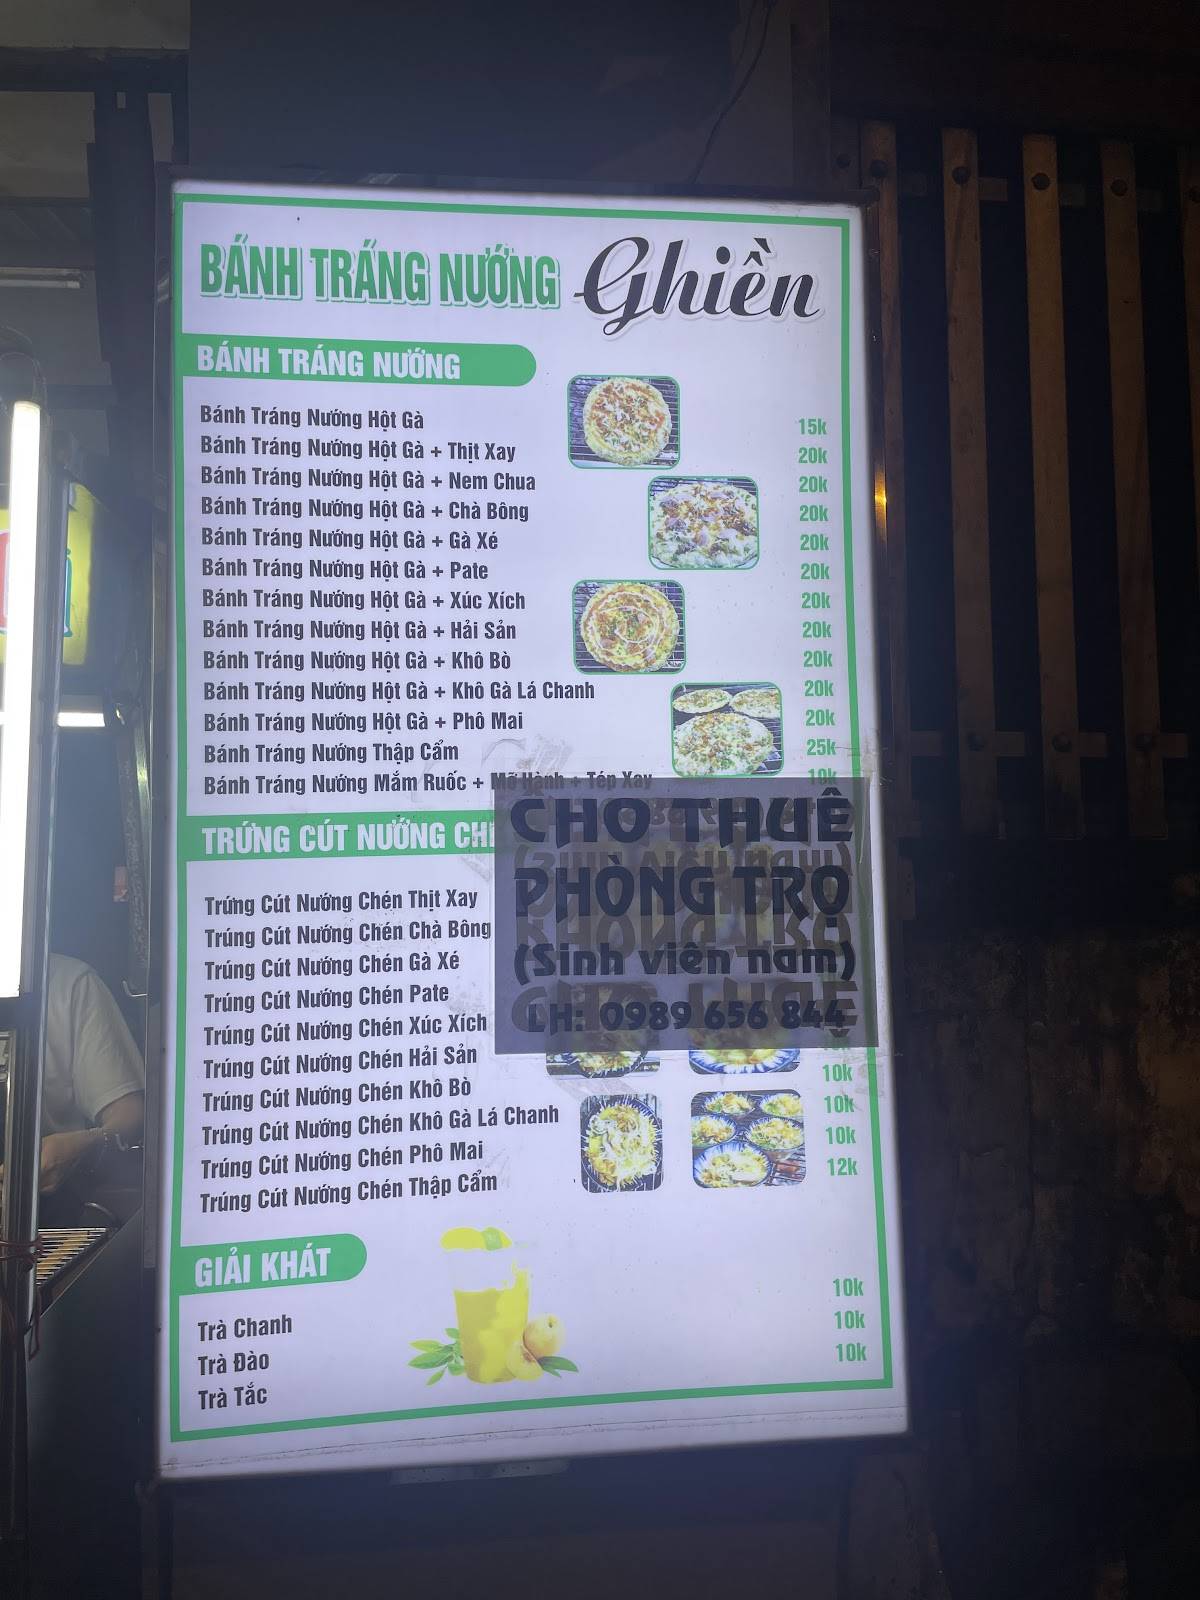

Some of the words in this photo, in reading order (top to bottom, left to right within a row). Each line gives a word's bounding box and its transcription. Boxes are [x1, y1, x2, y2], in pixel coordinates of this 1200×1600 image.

[200, 233, 300, 298] BÁNH
[310, 238, 429, 302] TRÁNG
[439, 244, 558, 305] NƯỚNG
[574, 237, 820, 335] Ghiền
[197, 341, 270, 374] BÁNH
[278, 344, 364, 377] TRÁNG
[373, 347, 461, 379] NƯỚNG
[201, 405, 246, 423] Bánh
[251, 407, 301, 427] Tráng
[308, 409, 363, 429] Nướng
[369, 411, 397, 432] Hột
[402, 411, 424, 428] Gà
[800, 419, 826, 435] 15k
[201, 435, 246, 454] Bánh
[252, 437, 302, 458] Tráng
[308, 439, 363, 459] Nướng
[369, 440, 397, 461] Hột
[403, 441, 424, 458] Gà
[448, 442, 480, 463] Thịt
[485, 443, 516, 462] Xay
[800, 447, 827, 464] 20k
[203, 558, 248, 576] Bánh
[253, 559, 303, 579] Tráng
[310, 560, 365, 580] Nướng
[371, 560, 399, 582] Hột
[404, 561, 426, 578] Gà
[451, 562, 489, 579] Pate
[800, 563, 831, 579] 20k
[203, 588, 248, 607] Bánh
[254, 589, 304, 609] Tráng
[310, 590, 365, 610] Nướng
[371, 591, 400, 612] Hột
[405, 591, 426, 608] Gà
[451, 591, 482, 609] Xúc
[488, 592, 526, 609] Xích
[801, 592, 830, 608] 20k
[204, 650, 249, 669] Bánh
[255, 650, 305, 671] Tráng
[311, 651, 366, 671] Nướng
[372, 651, 400, 673] Hột
[406, 651, 428, 669] Gà
[452, 652, 484, 669] Khô
[490, 651, 511, 669] Bò
[804, 650, 832, 668] 20k
[204, 682, 249, 700] Bánh
[255, 682, 305, 702] Tráng
[312, 681, 367, 701] Nướng
[373, 682, 401, 703] Hột
[407, 681, 428, 699] Gà
[453, 682, 485, 699] Khô
[491, 681, 512, 699] Gà
[518, 681, 537, 699] Lá
[543, 682, 595, 698] Chanh
[804, 680, 832, 697] 20k
[205, 744, 250, 763] Bánh
[256, 744, 306, 764] Tráng
[313, 743, 367, 763] Nướng
[373, 743, 415, 764] Thập
[421, 739, 459, 760] Cẩm
[806, 739, 835, 756] 25k
[205, 776, 250, 794] Bánh
[256, 775, 306, 795] Tráng
[313, 774, 368, 794] Nướng
[375, 771, 418, 791] Mắm
[424, 770, 467, 790] Ruốc
[522, 771, 564, 789] Hành
[586, 771, 616, 790] Tép
[622, 771, 653, 789] Xay
[510, 797, 651, 848] CHO
[672, 787, 853, 848] THUÊ
[202, 820, 291, 855] TRỨNG
[300, 819, 348, 852] CÚT
[357, 817, 446, 850] NƯỚNG
[454, 820, 495, 849] CH
[205, 896, 255, 916] Trứng
[262, 894, 291, 913] Cút
[297, 893, 353, 913] Nướng
[359, 891, 403, 911] Chén
[408, 890, 441, 911] Thịt
[447, 889, 478, 908] Xay
[514, 855, 715, 923] PHÒNG
[732, 865, 850, 928] TRỌ
[262, 926, 291, 945] Cút
[298, 924, 353, 944] Nướng
[360, 922, 403, 941] Chén
[410, 920, 442, 940] Chà
[449, 920, 491, 939] Bông
[514, 942, 624, 985] (Sinh
[639, 942, 731, 975] viên
[747, 940, 855, 981] nam)
[262, 990, 291, 1010] Cút
[297, 988, 353, 1008] Nướng
[359, 985, 403, 1005] Chén
[410, 984, 449, 1002] Pate
[261, 1023, 291, 1042] Cút
[297, 1020, 353, 1040] Nướng
[359, 1017, 403, 1037] Chén
[410, 1015, 442, 1034] Xúc
[449, 1013, 487, 1032] Xích
[528, 1003, 583, 1035] LH:
[600, 1002, 692, 1031] 0989
[704, 1001, 768, 1030] 656
[781, 1000, 845, 1030] 844
[824, 1064, 853, 1081] 10k
[261, 1088, 290, 1108] Cút
[296, 1085, 352, 1106] Nướng
[359, 1081, 403, 1102] Chén
[410, 1079, 443, 1099] Khô
[449, 1077, 471, 1096] Bò
[824, 1095, 854, 1113] 10k
[260, 1121, 290, 1141] Cút
[296, 1118, 352, 1139] Nướng
[359, 1114, 403, 1135] Chén
[410, 1111, 443, 1131] Khô
[450, 1109, 472, 1128] Gà
[478, 1107, 498, 1126] Lá
[505, 1105, 559, 1125] Chanh
[827, 1126, 855, 1145] 10k
[828, 1158, 857, 1176] 12k
[258, 1188, 288, 1208] Cút
[295, 1184, 352, 1206] Nướng
[358, 1179, 403, 1200] Chén
[409, 1176, 452, 1199] Thập
[458, 1170, 497, 1192] Cẩm
[194, 1246, 251, 1288] GIẢI
[261, 1242, 331, 1282] KHÁT
[834, 1278, 863, 1296] 10k
[198, 1320, 227, 1341] Trà
[234, 1315, 292, 1338] Chanh
[836, 1312, 864, 1328] 10k
[198, 1354, 227, 1375] Trà
[233, 1351, 270, 1372] Đào
[838, 1344, 865, 1360] 10k
[198, 1388, 228, 1409] Trà
[234, 1382, 268, 1406] Tắc
